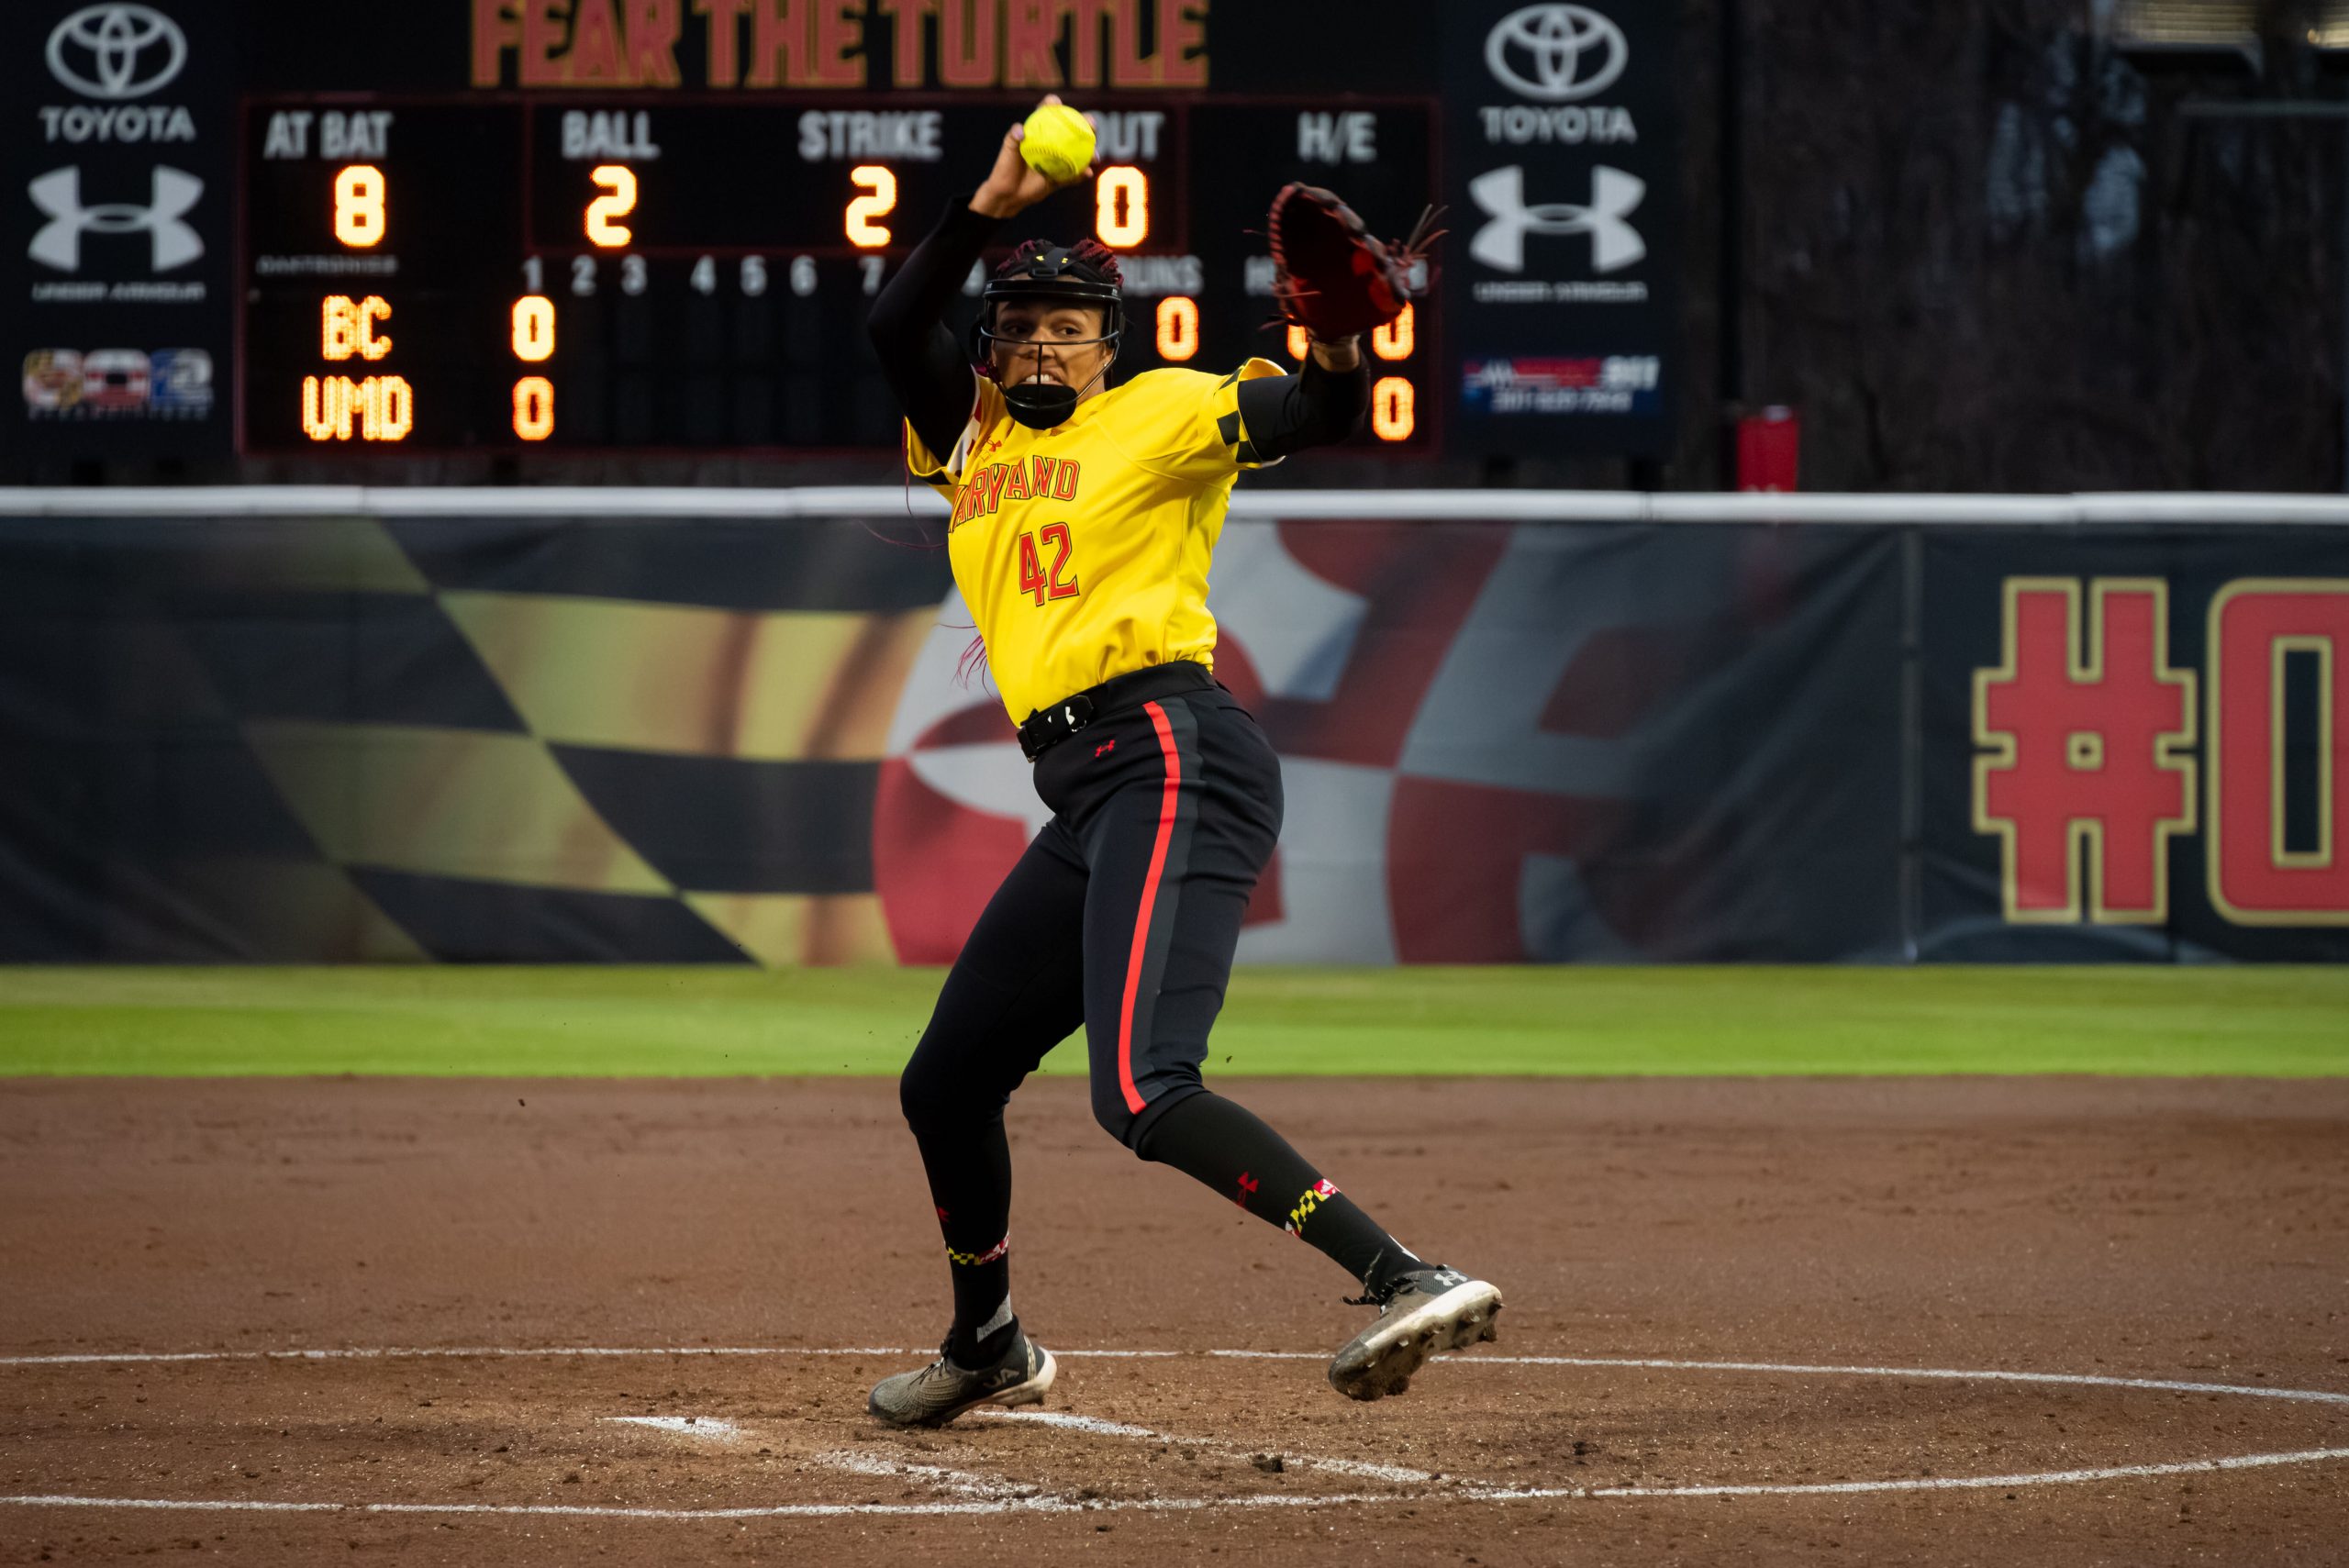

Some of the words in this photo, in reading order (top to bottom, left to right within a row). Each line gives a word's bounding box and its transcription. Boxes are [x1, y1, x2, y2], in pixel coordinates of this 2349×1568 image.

[470, 0, 683, 88] FEAR
[692, 0, 868, 88] THE
[878, 0, 1209, 88] TURTLE
[39, 106, 196, 142] TOYOTA
[264, 111, 313, 159] AT
[320, 111, 393, 159] BAT
[561, 110, 660, 160] BALL
[797, 110, 942, 161] STRIKE
[1297, 111, 1377, 162] H/E
[1479, 106, 1638, 143] TOYOTA
[333, 164, 386, 249] 8
[584, 164, 638, 249] 2
[844, 164, 897, 249] 2
[1096, 165, 1149, 249] 0
[522, 255, 543, 294] 1
[571, 255, 596, 295] 2
[621, 255, 647, 295] 3
[690, 255, 716, 295] 4
[740, 255, 767, 295] 5
[790, 255, 817, 295] 6
[859, 255, 885, 295] 7
[321, 295, 393, 361] BC
[511, 295, 555, 361] 0
[1156, 296, 1198, 361] 0
[302, 375, 413, 441] UMD
[512, 376, 554, 440] 0
[1373, 376, 1414, 440] 0
[1019, 522, 1080, 606] 42
